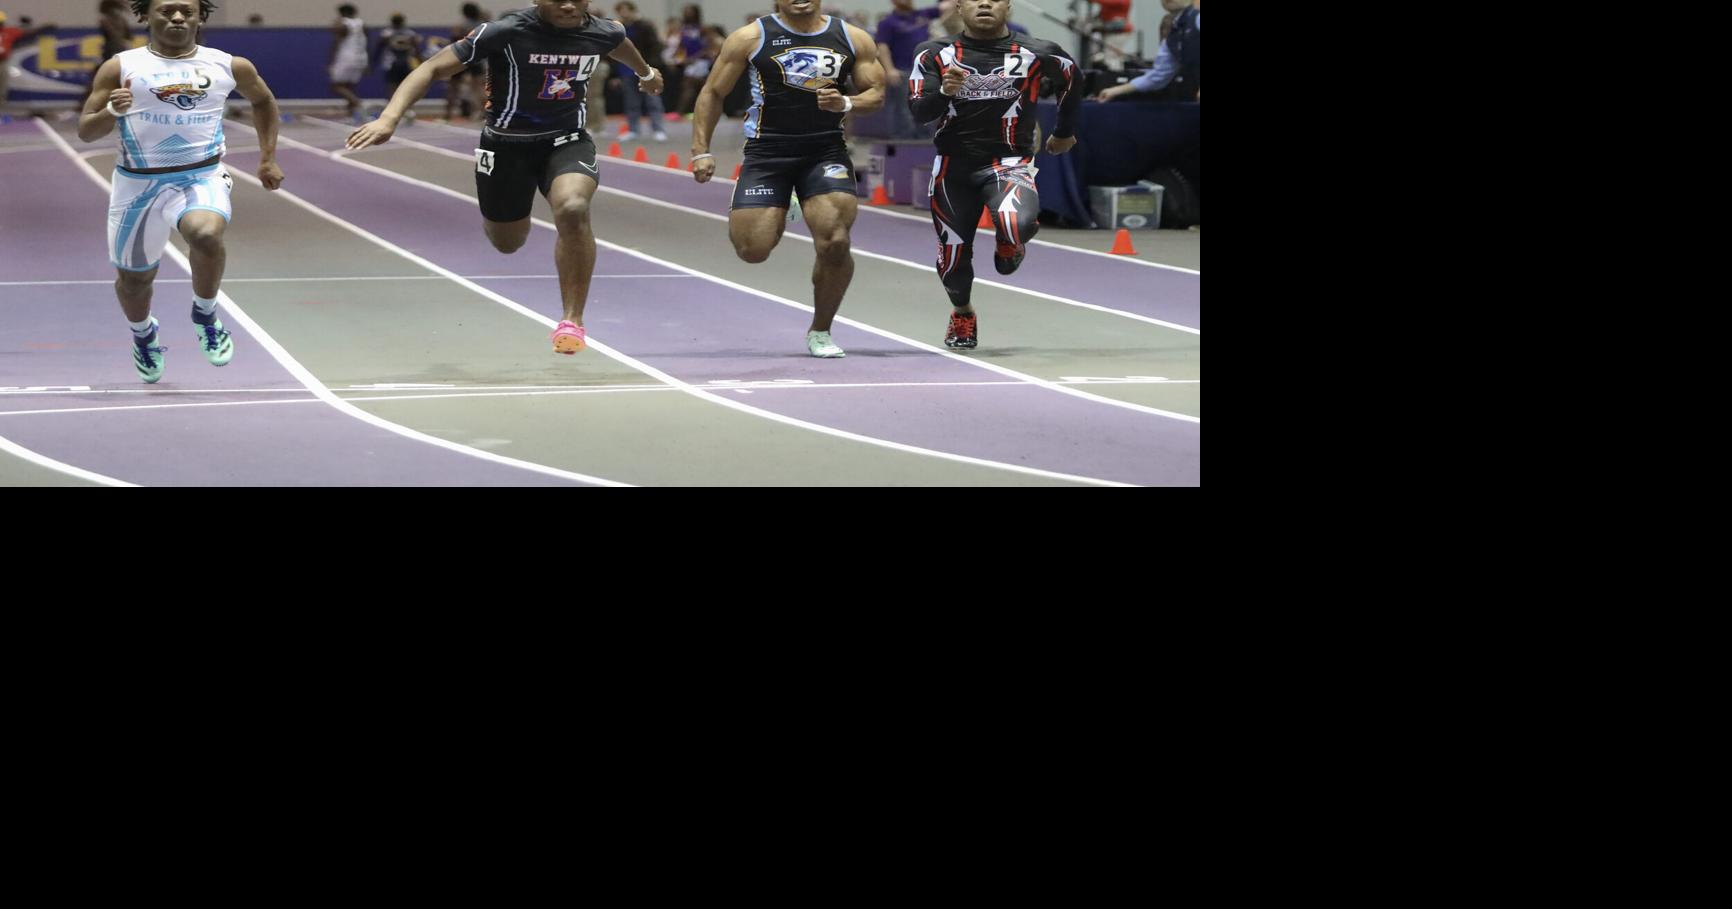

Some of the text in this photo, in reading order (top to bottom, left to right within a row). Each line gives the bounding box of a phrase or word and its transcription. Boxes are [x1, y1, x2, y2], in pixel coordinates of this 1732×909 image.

[528, 53, 580, 65] KENTW
[581, 56, 595, 76] 4
[822, 55, 836, 77] 3
[1009, 54, 1023, 76] 2
[194, 67, 212, 90] 5
[990, 90, 1014, 98] FIELD
[139, 111, 170, 125] TRACK
[175, 114, 184, 125] &
[480, 152, 491, 172] 4
[745, 188, 774, 196] ELITE
